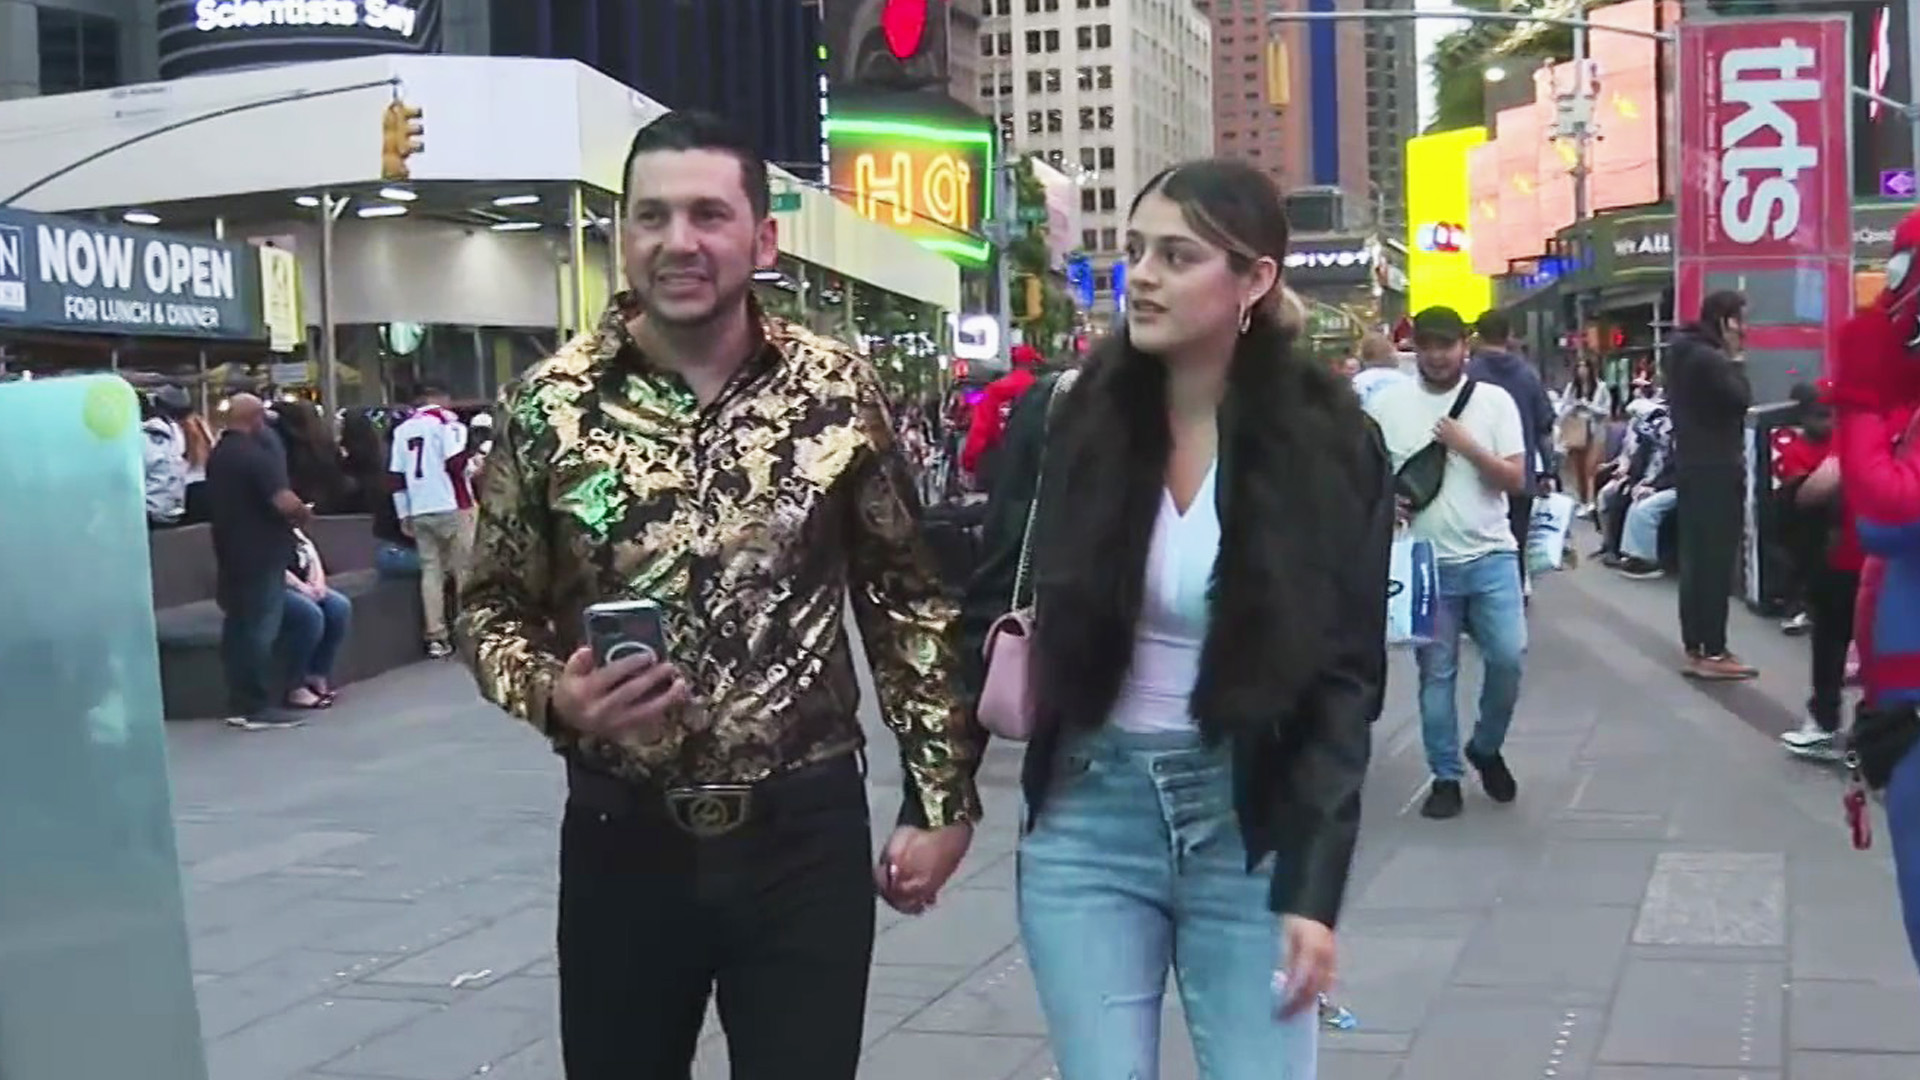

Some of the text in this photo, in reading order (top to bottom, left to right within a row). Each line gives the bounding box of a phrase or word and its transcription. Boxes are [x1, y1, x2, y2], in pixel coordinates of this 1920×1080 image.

[195, 0, 416, 37] Scientists Say
[1720, 38, 1821, 244] tkts
[37, 224, 135, 288] NOW
[144, 240, 234, 299] OPEN
[64, 296, 220, 329] FOR LUNCH & DINNER
[407, 436, 424, 478] 7
